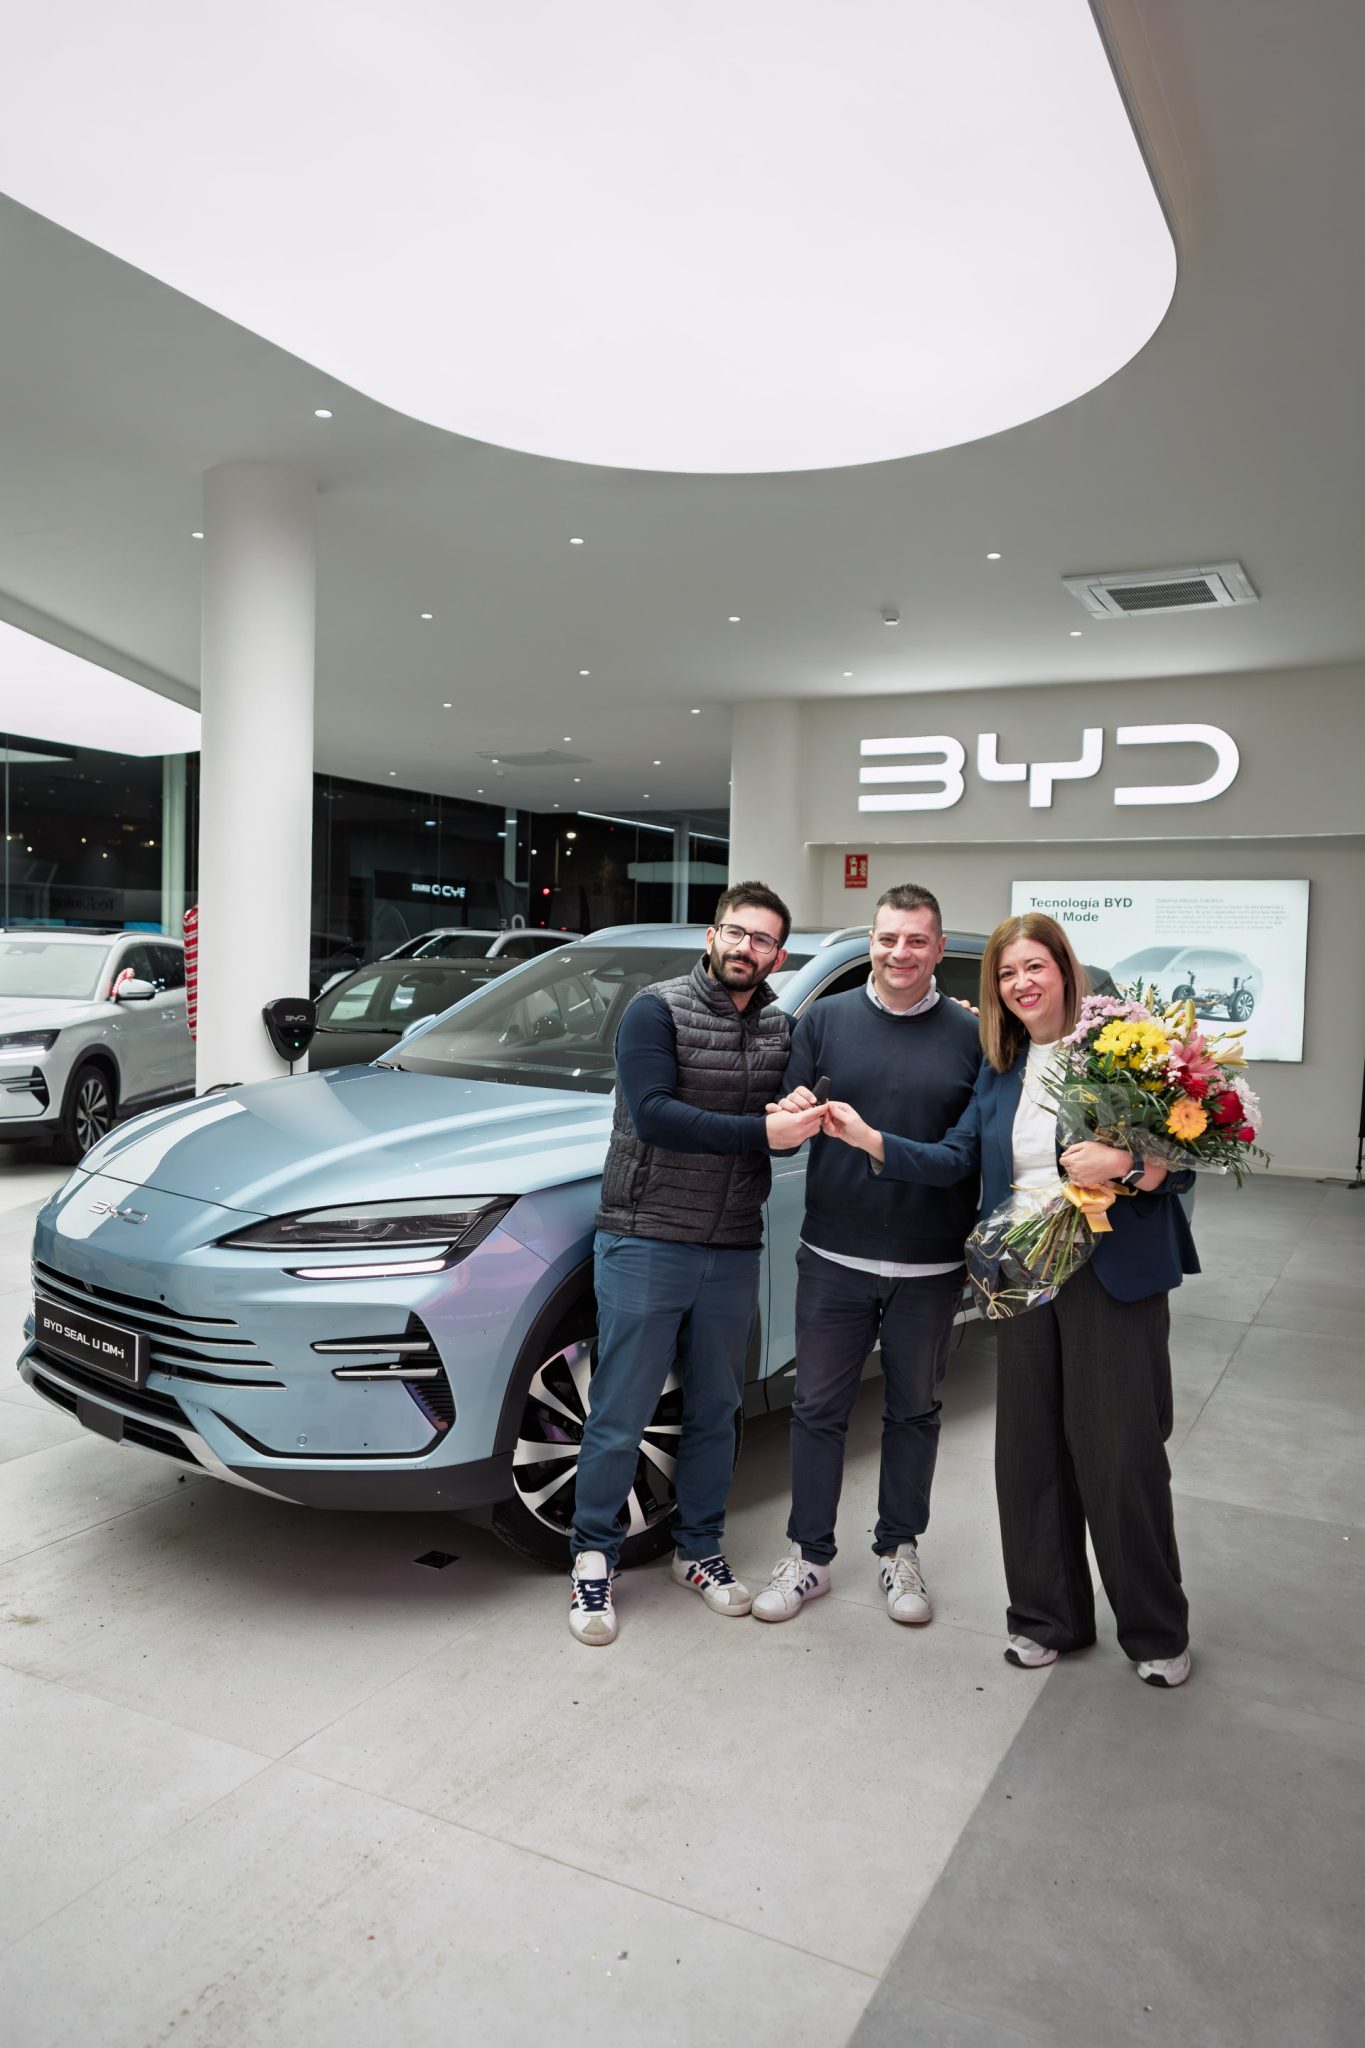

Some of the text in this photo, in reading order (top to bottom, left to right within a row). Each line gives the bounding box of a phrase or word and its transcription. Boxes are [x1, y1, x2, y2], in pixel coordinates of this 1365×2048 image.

[858, 723, 1240, 812] BYD
[1030, 897, 1133, 909] Tecnología BYD
[1063, 911, 1099, 922] Mode
[754, 1036, 781, 1045] BYD
[89, 1200, 148, 1225] BYD
[43, 1317, 125, 1359] BYD SEAL U DM-i
